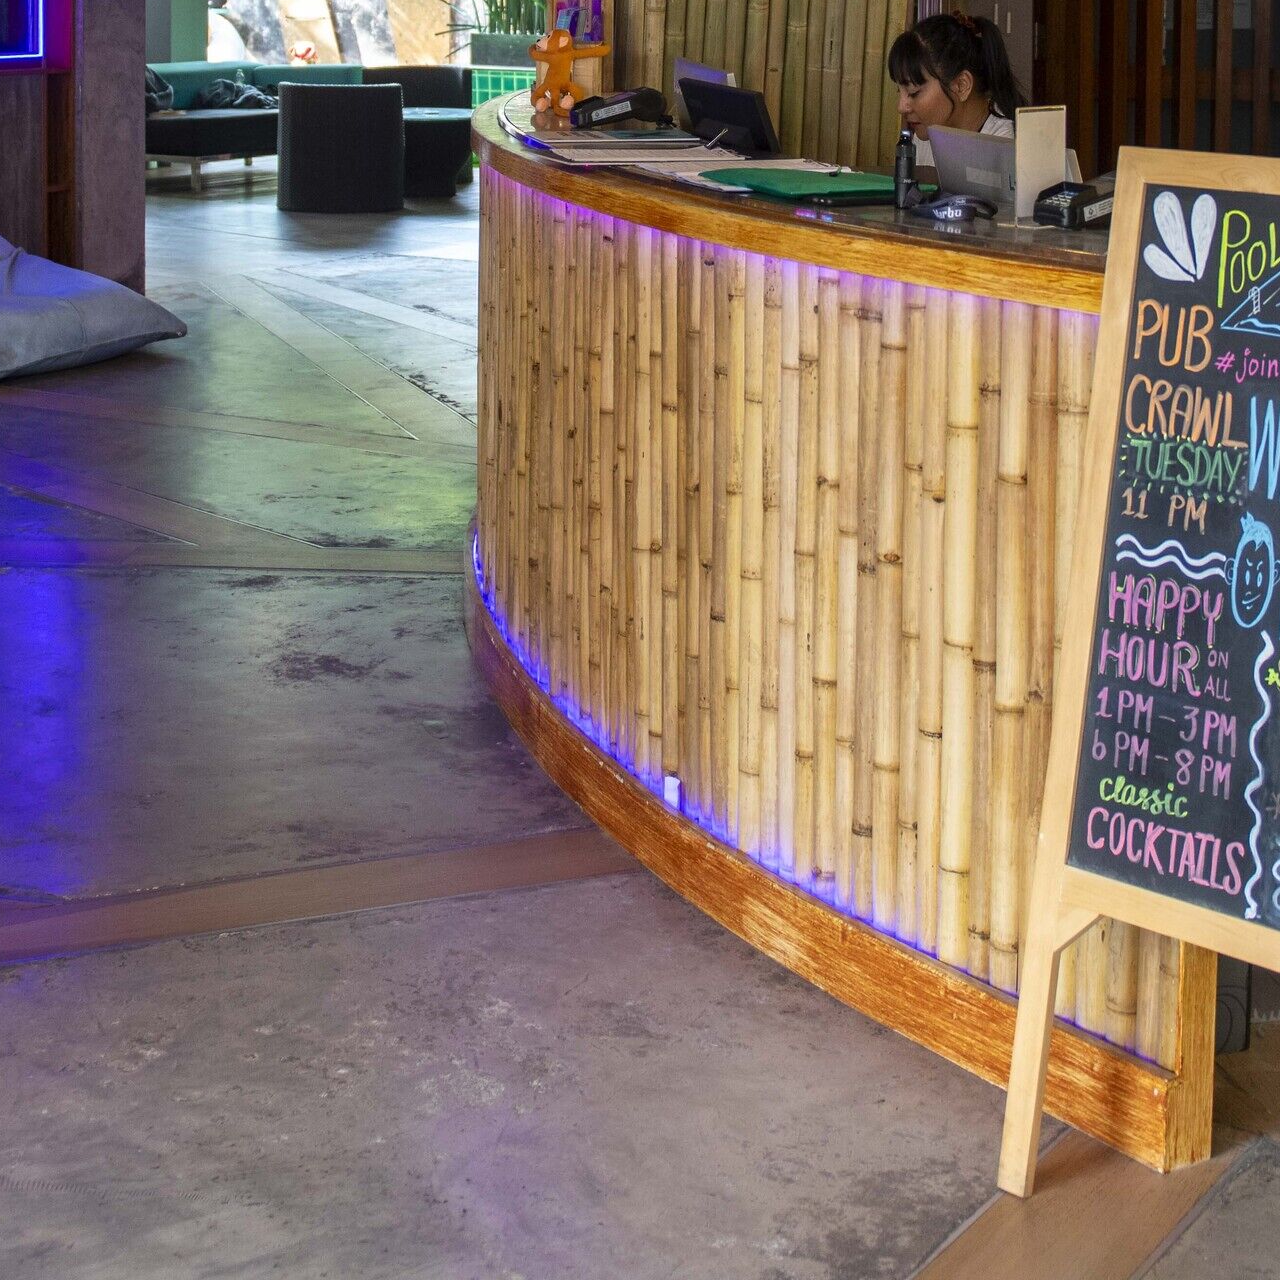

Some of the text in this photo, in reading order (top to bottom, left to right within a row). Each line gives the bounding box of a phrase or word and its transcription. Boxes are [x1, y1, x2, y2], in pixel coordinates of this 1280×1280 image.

[1133, 298, 1214, 373] PUB
[1125, 378, 1249, 450] CRAWL
[1128, 439, 1244, 493] TUESDAY
[1167, 494, 1209, 535] PM
[1108, 570, 1225, 649] HAPPY
[1097, 627, 1202, 697] HOUR
[1204, 674, 1232, 702] ALL
[1207, 649, 1230, 670] ON
[1099, 775, 1189, 818] classic
[1086, 806, 1246, 896] COCKTAILS
